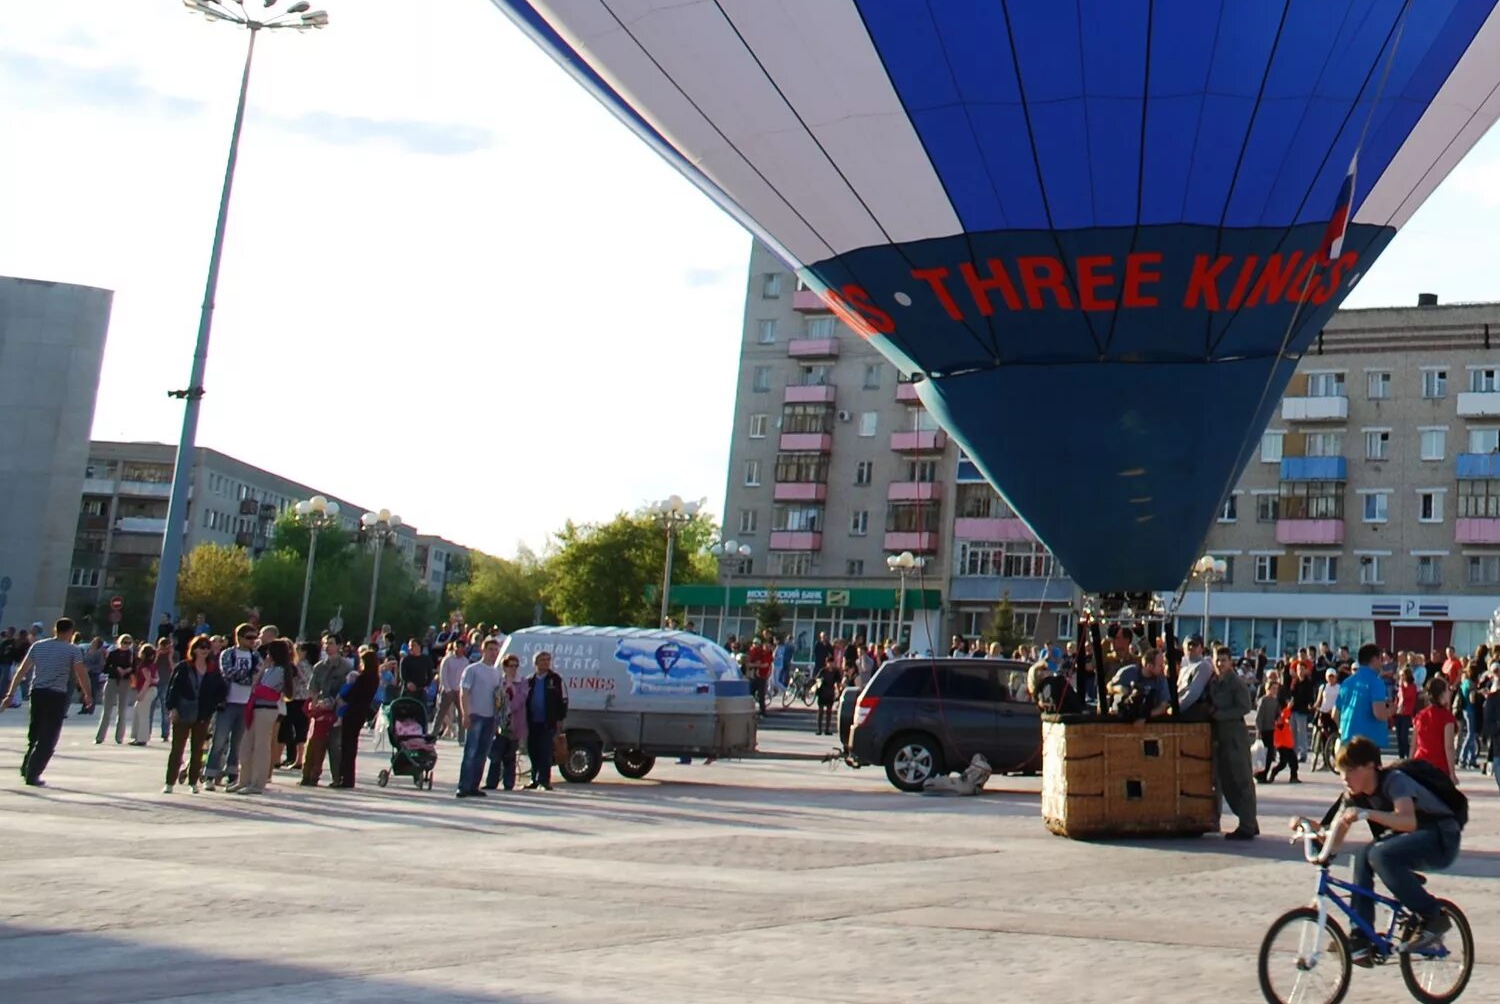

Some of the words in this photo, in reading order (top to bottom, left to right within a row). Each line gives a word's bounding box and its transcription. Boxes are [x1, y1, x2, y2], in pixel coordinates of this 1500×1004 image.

[911, 252, 1164, 321] THREE
[1183, 250, 1361, 312] KINGS
[523, 642, 594, 656] КОМАНДА
[569, 676, 615, 690] KINGS
